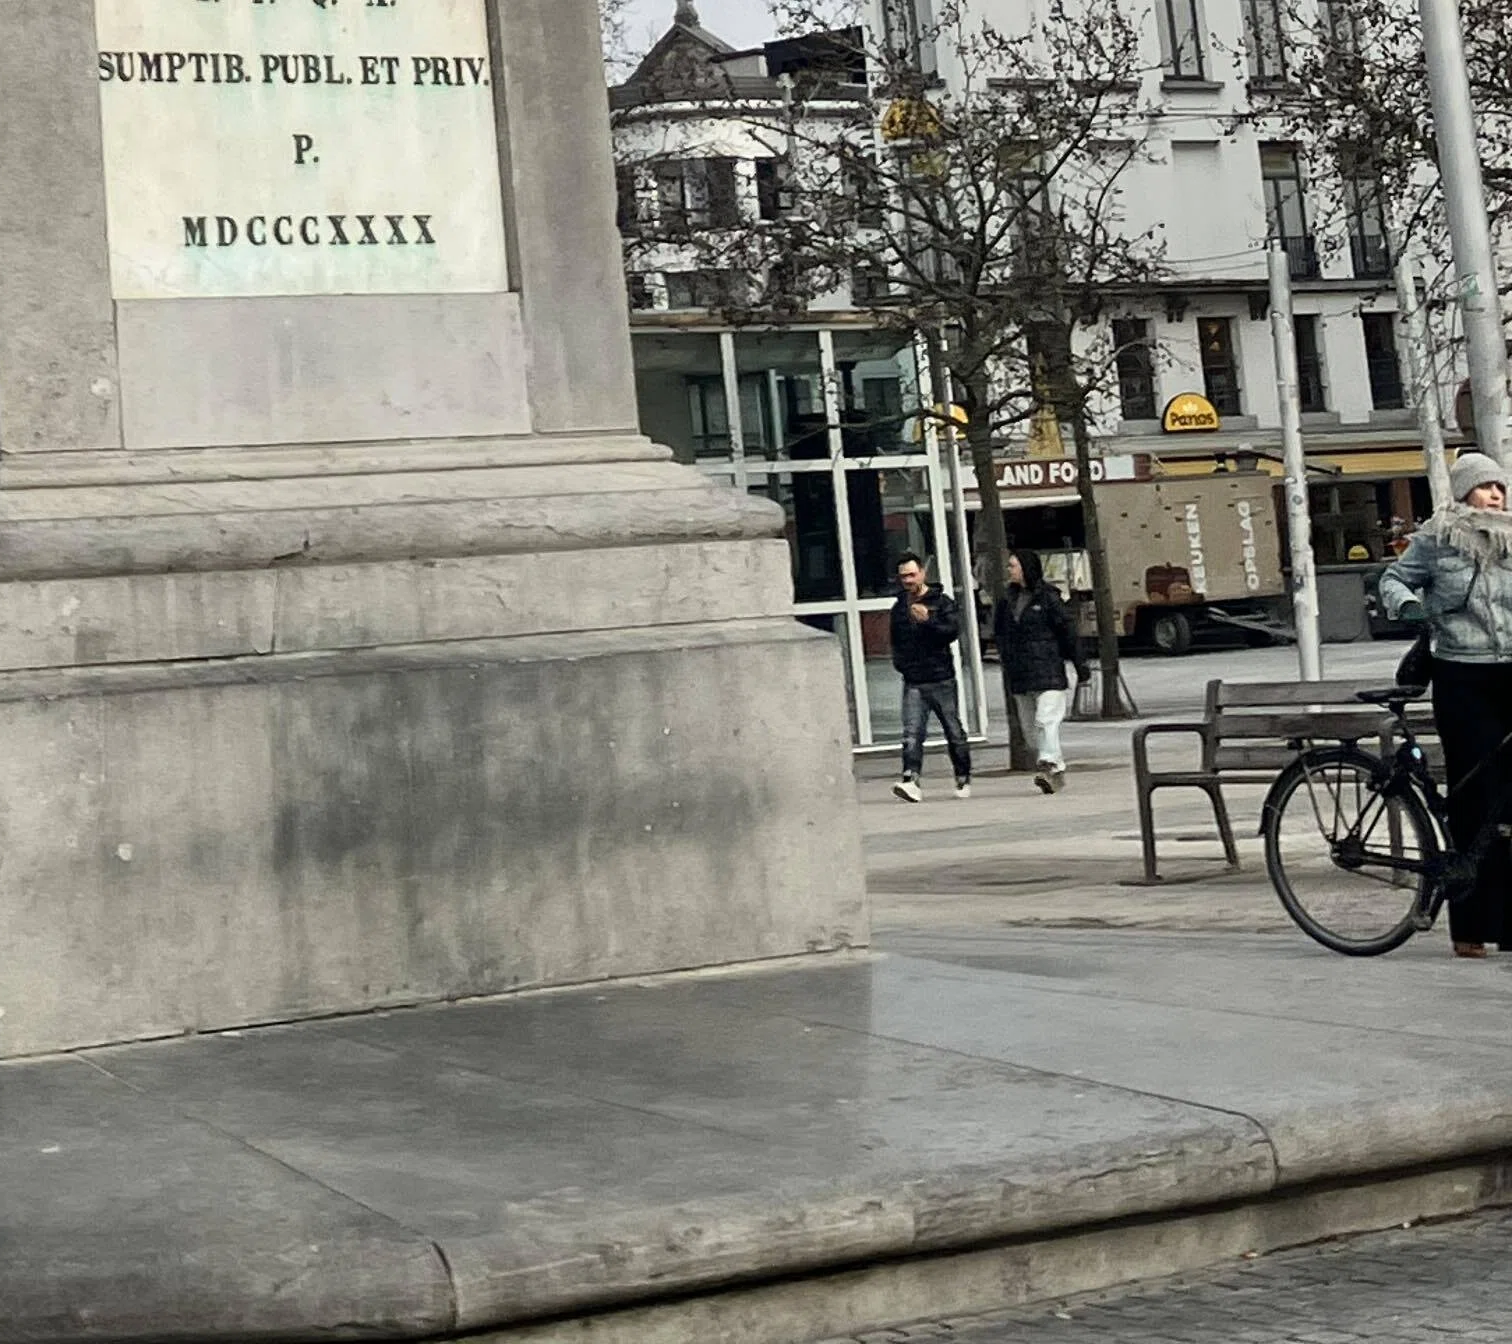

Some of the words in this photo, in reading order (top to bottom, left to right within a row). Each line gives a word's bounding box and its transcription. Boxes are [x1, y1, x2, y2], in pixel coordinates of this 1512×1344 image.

[97, 51, 251, 84] SUMPTIB.
[259, 54, 353, 85] PUBL.
[358, 55, 400, 85] ET
[411, 56, 490, 87] PRIV.
[292, 134, 319, 165] P.
[182, 214, 436, 247] MDCCCXXXX
[1048, 460, 1104, 484] FOD
